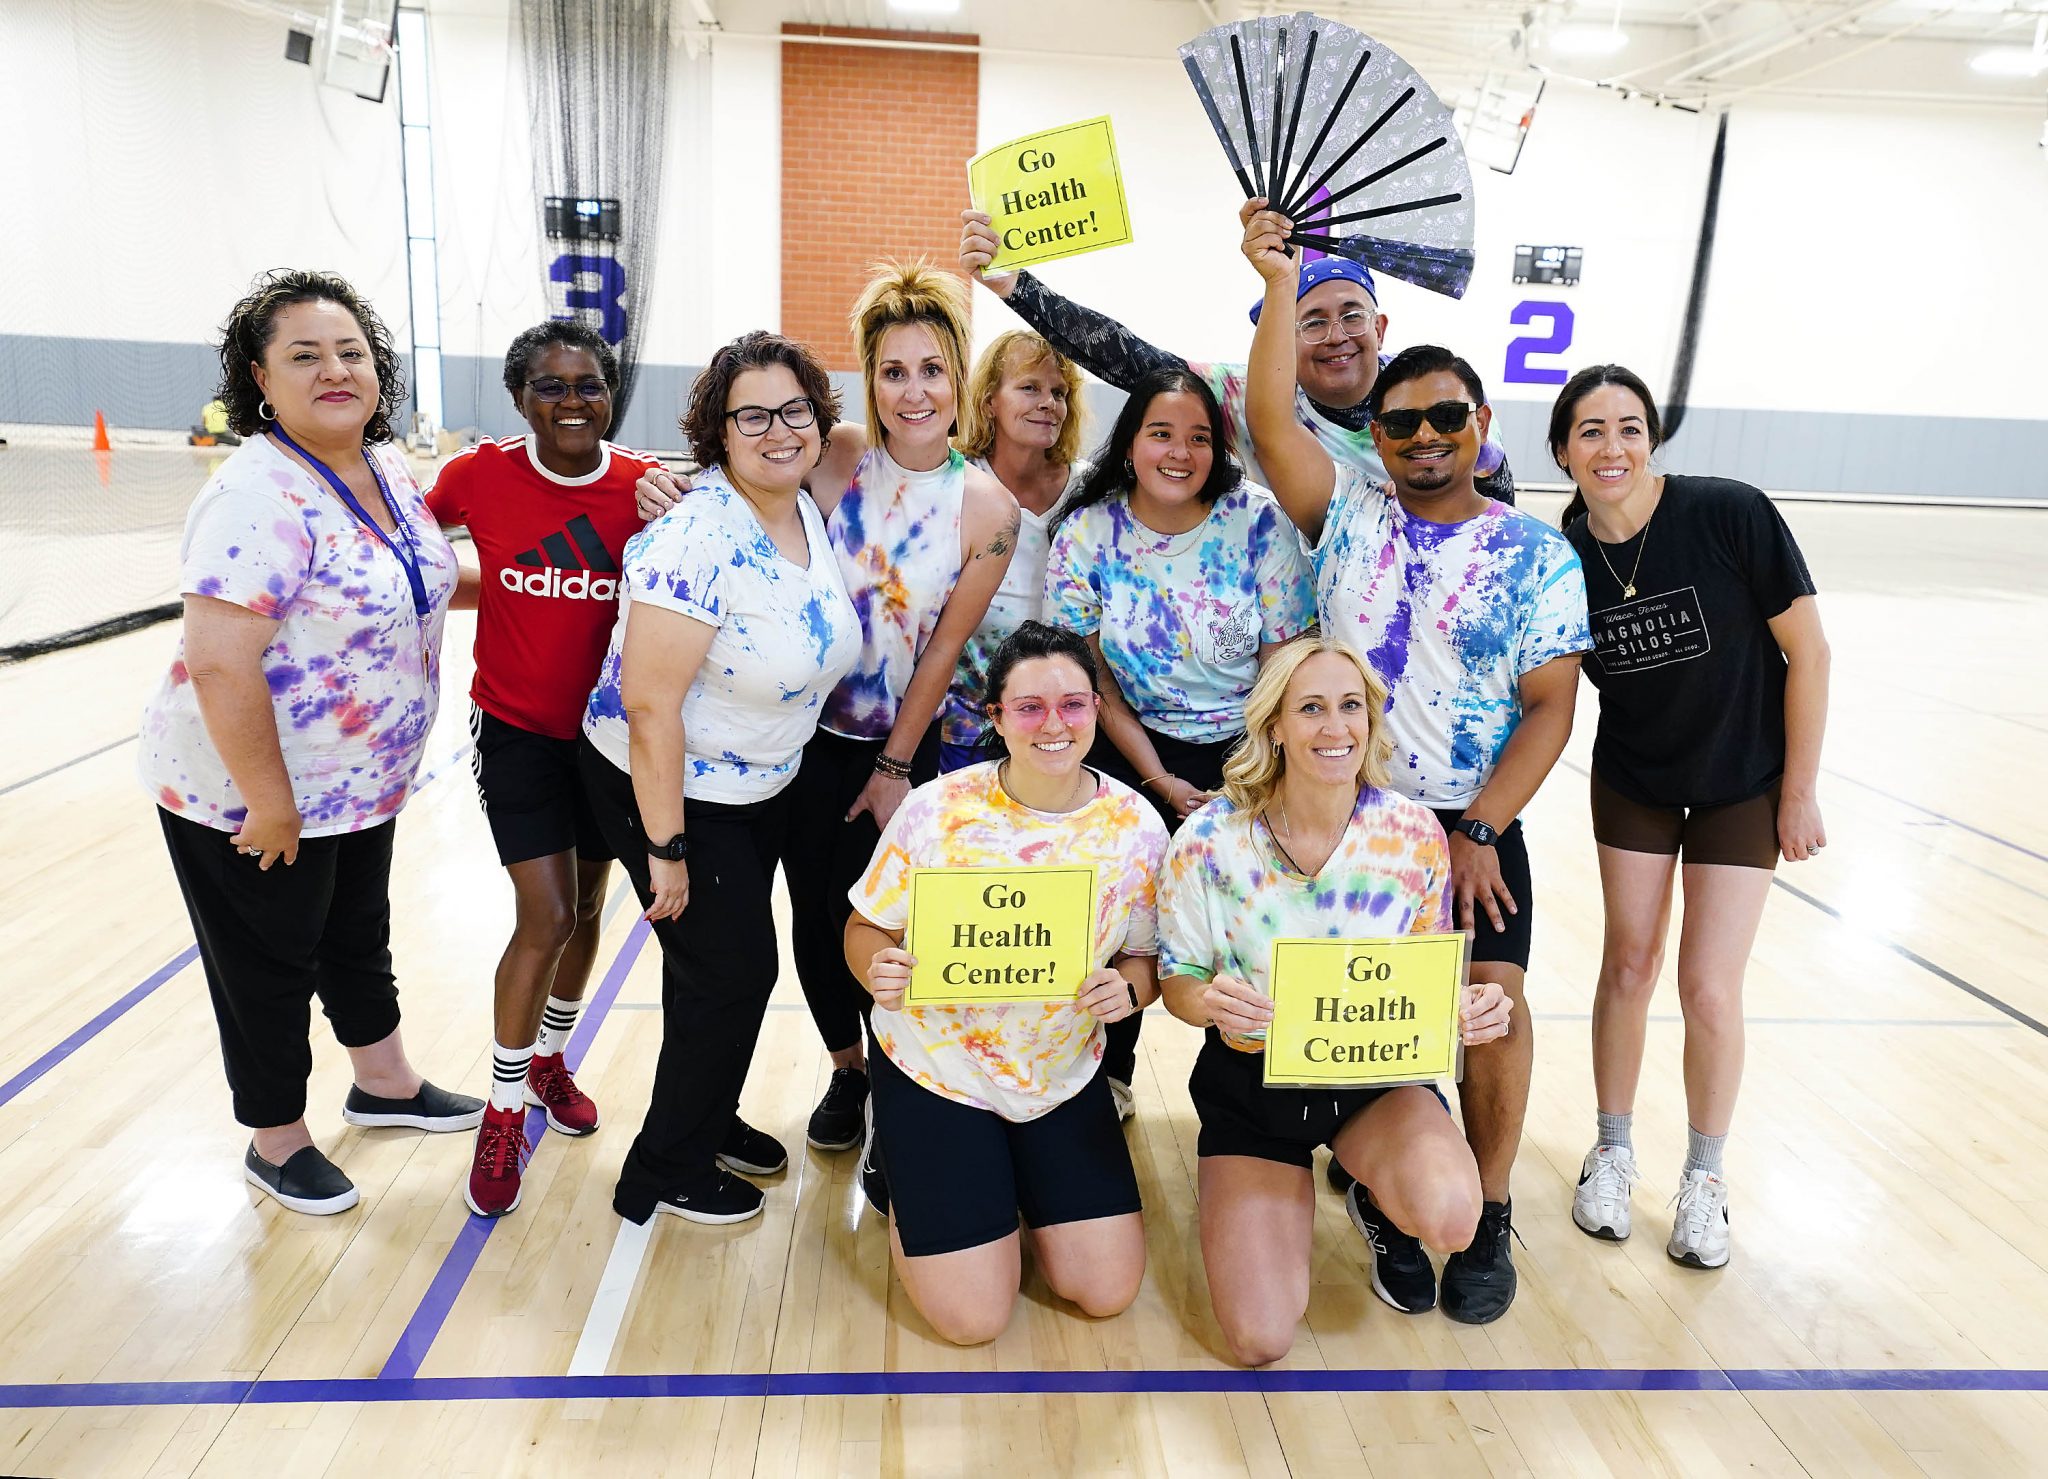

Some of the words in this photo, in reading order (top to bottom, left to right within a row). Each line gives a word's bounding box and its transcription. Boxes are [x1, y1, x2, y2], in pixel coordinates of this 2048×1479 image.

[1018, 148, 1055, 173] Go
[1001, 177, 1088, 216] Health
[1003, 210, 1099, 251] Center!
[548, 254, 628, 346] 3
[1503, 300, 1575, 385] 2
[499, 566, 620, 601] adida
[1637, 602, 1669, 616] Texas
[1593, 610, 1691, 645] MAGNOLIA
[1618, 632, 1673, 656] SILOS
[983, 884, 1027, 909] Go
[951, 923, 1052, 948] Health
[942, 961, 1056, 985] Center!
[1347, 956, 1391, 982] Go
[1313, 995, 1416, 1023] Health
[1303, 1035, 1420, 1063] Center!
